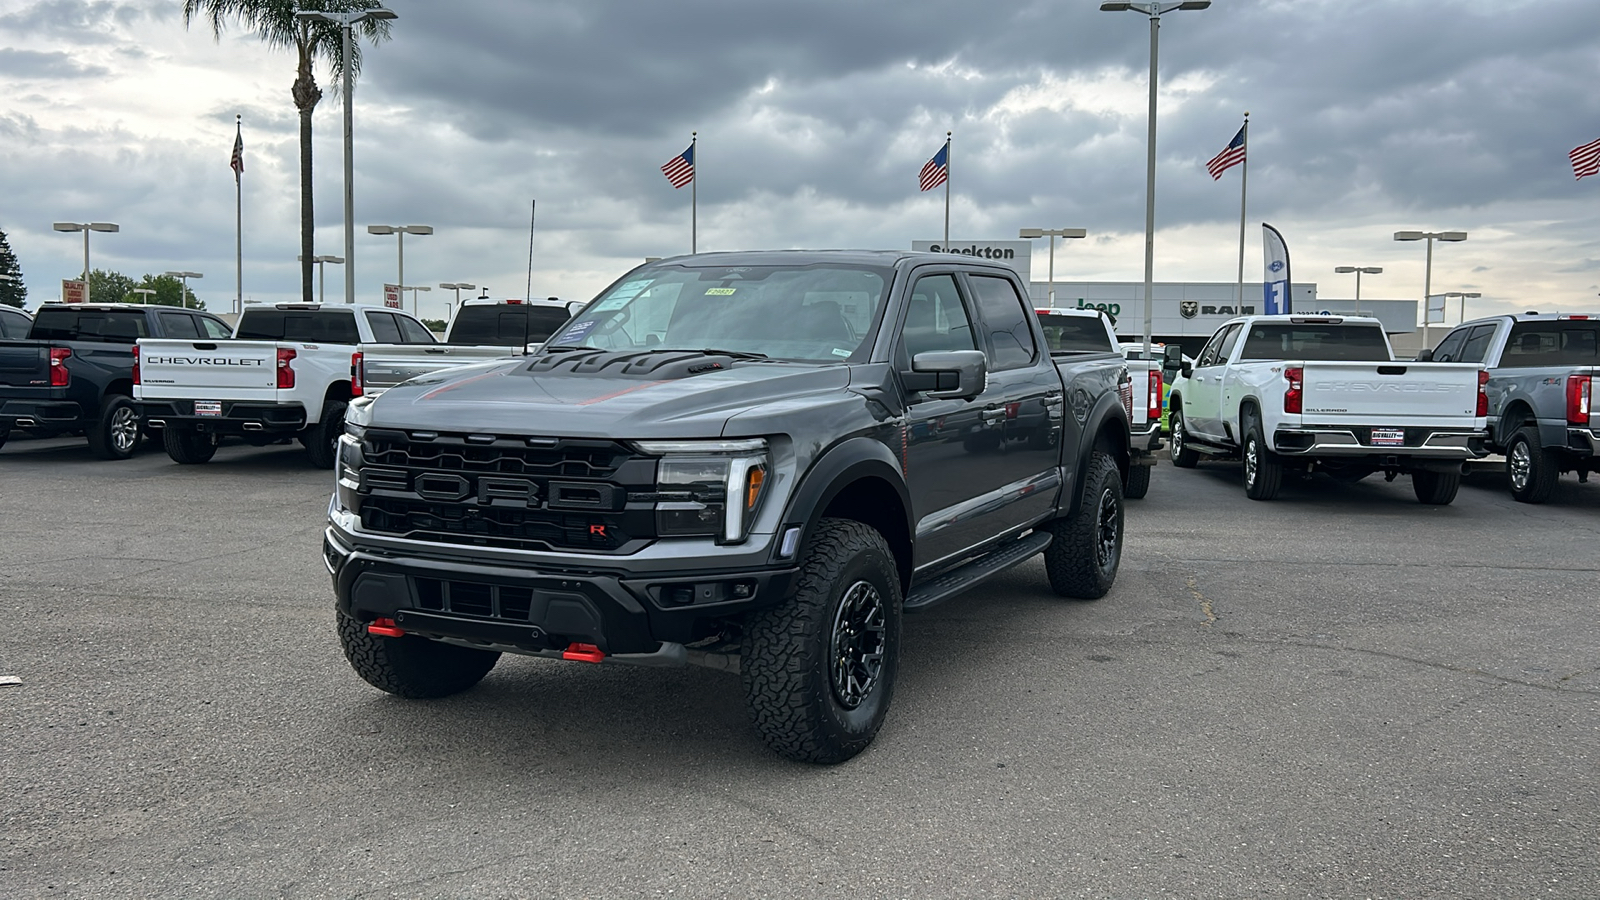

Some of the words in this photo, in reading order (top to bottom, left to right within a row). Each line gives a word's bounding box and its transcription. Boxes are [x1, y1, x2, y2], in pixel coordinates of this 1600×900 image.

[930, 244, 1014, 259] Sockton
[1201, 306, 1255, 315] RAM
[147, 356, 266, 366] CHEVROLET
[1315, 381, 1467, 394] CHEVROLET
[357, 467, 622, 513] FORD
[590, 525, 606, 536] R
